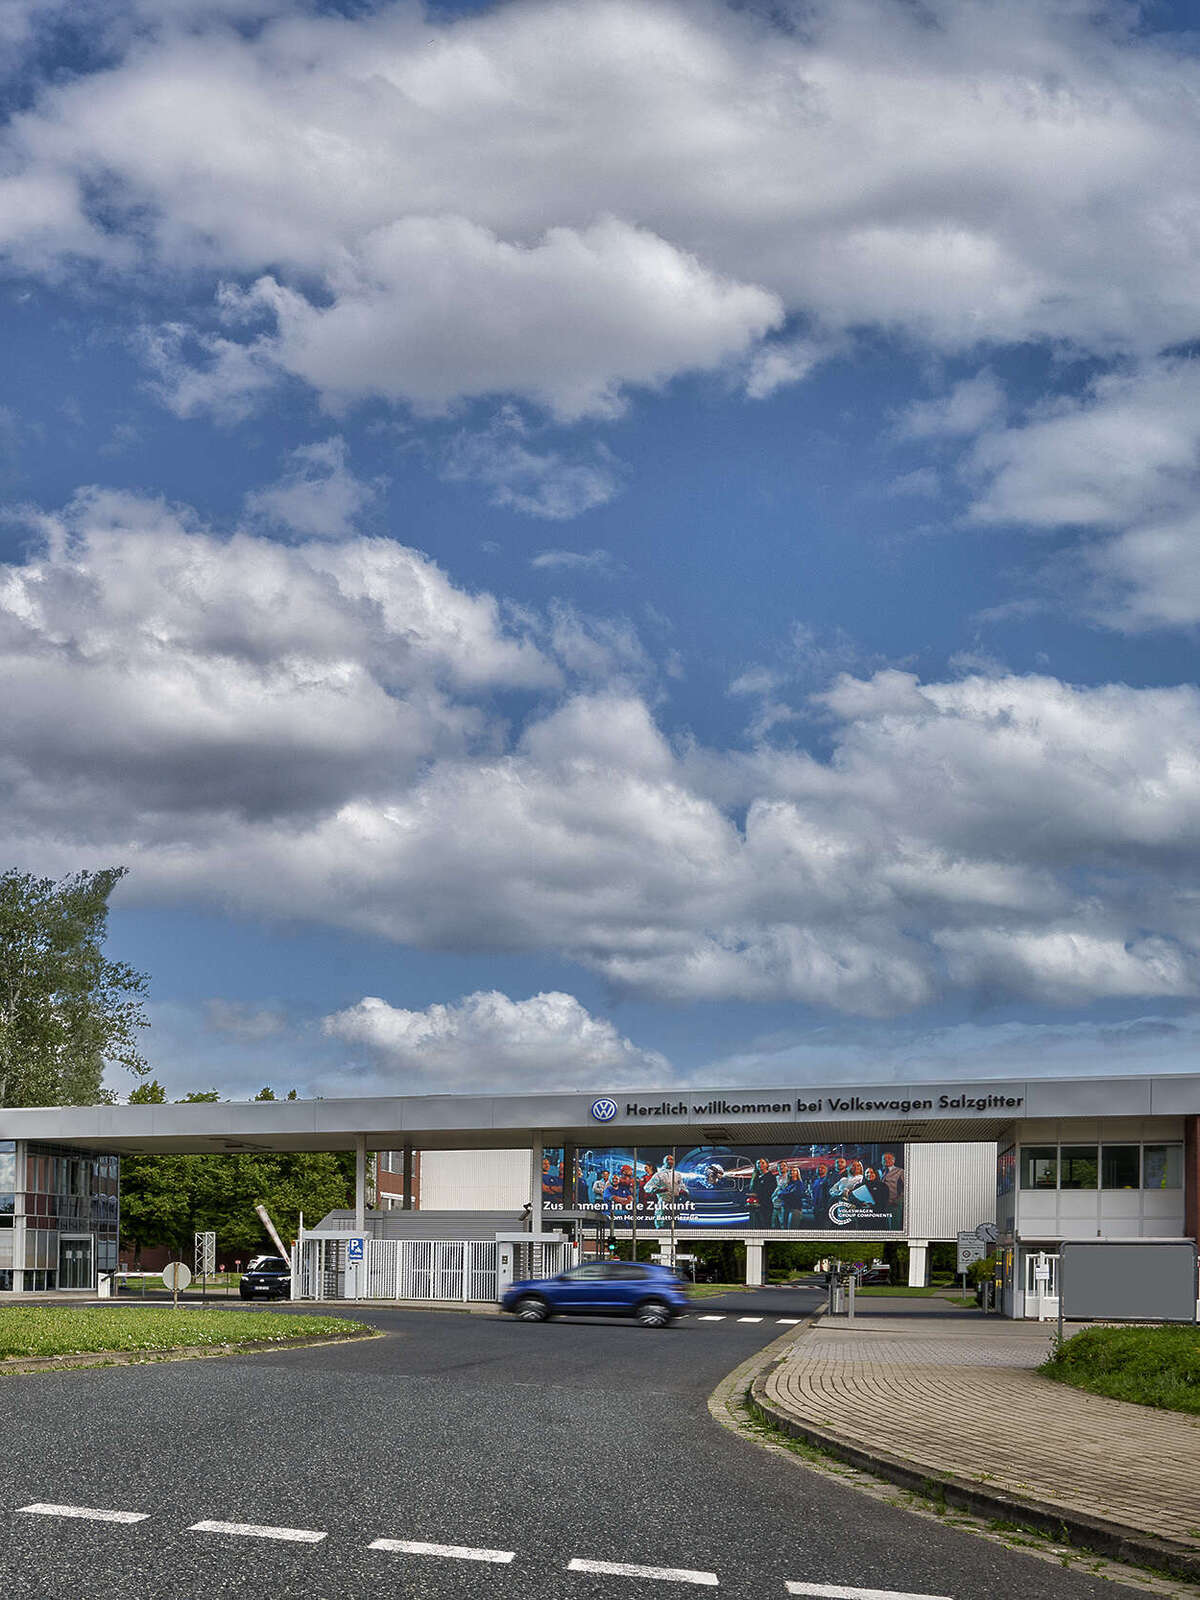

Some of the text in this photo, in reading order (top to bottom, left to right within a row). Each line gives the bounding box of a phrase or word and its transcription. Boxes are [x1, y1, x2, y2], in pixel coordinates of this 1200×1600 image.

[626, 1094, 1025, 1116] Herzlich willkommen bei Volkswagen Salzgitter
[543, 1201, 696, 1211] Zusmmen in de Zukunft
[351, 1239, 359, 1250] P
